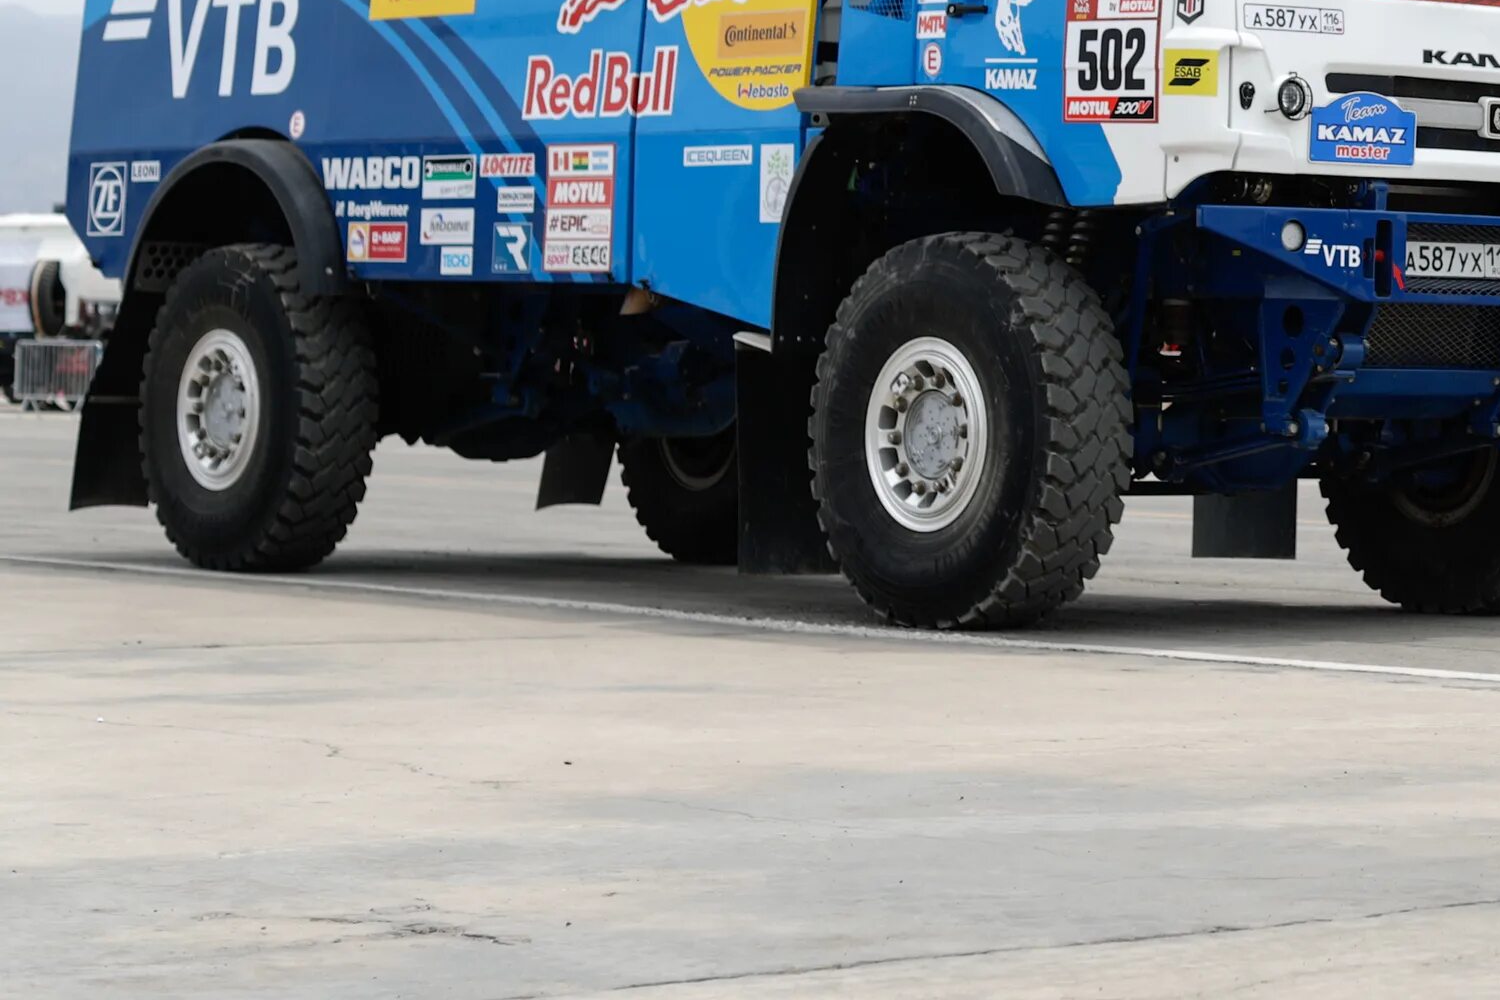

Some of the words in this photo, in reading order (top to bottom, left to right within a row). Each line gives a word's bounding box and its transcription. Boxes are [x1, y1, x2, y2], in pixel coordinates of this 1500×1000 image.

[1119, 0, 1155, 12] MOTUL
[1323, 12, 1340, 25] 116
[725, 23, 787, 46] Continental
[1078, 28, 1146, 91] 502
[708, 63, 802, 78] POWER-PACKER
[985, 68, 1038, 90] KAMAZ
[1174, 66, 1202, 78] ESAB
[524, 50, 602, 118] Red
[601, 46, 678, 116] Bull
[737, 83, 789, 99] Webasto
[1067, 101, 1112, 116] MOTUL
[1114, 100, 1152, 115] 300V
[1341, 97, 1387, 123] Team
[1317, 124, 1406, 144] KAMAZ
[1336, 143, 1390, 160] master
[133, 164, 159, 177] LEONI
[321, 155, 421, 190] WABCO
[482, 155, 533, 174] LOCTITE
[94, 180, 123, 219] ZF
[553, 180, 606, 204] MOTUL
[347, 200, 409, 220] BorgWarner
[1322, 245, 1361, 267] VTB
